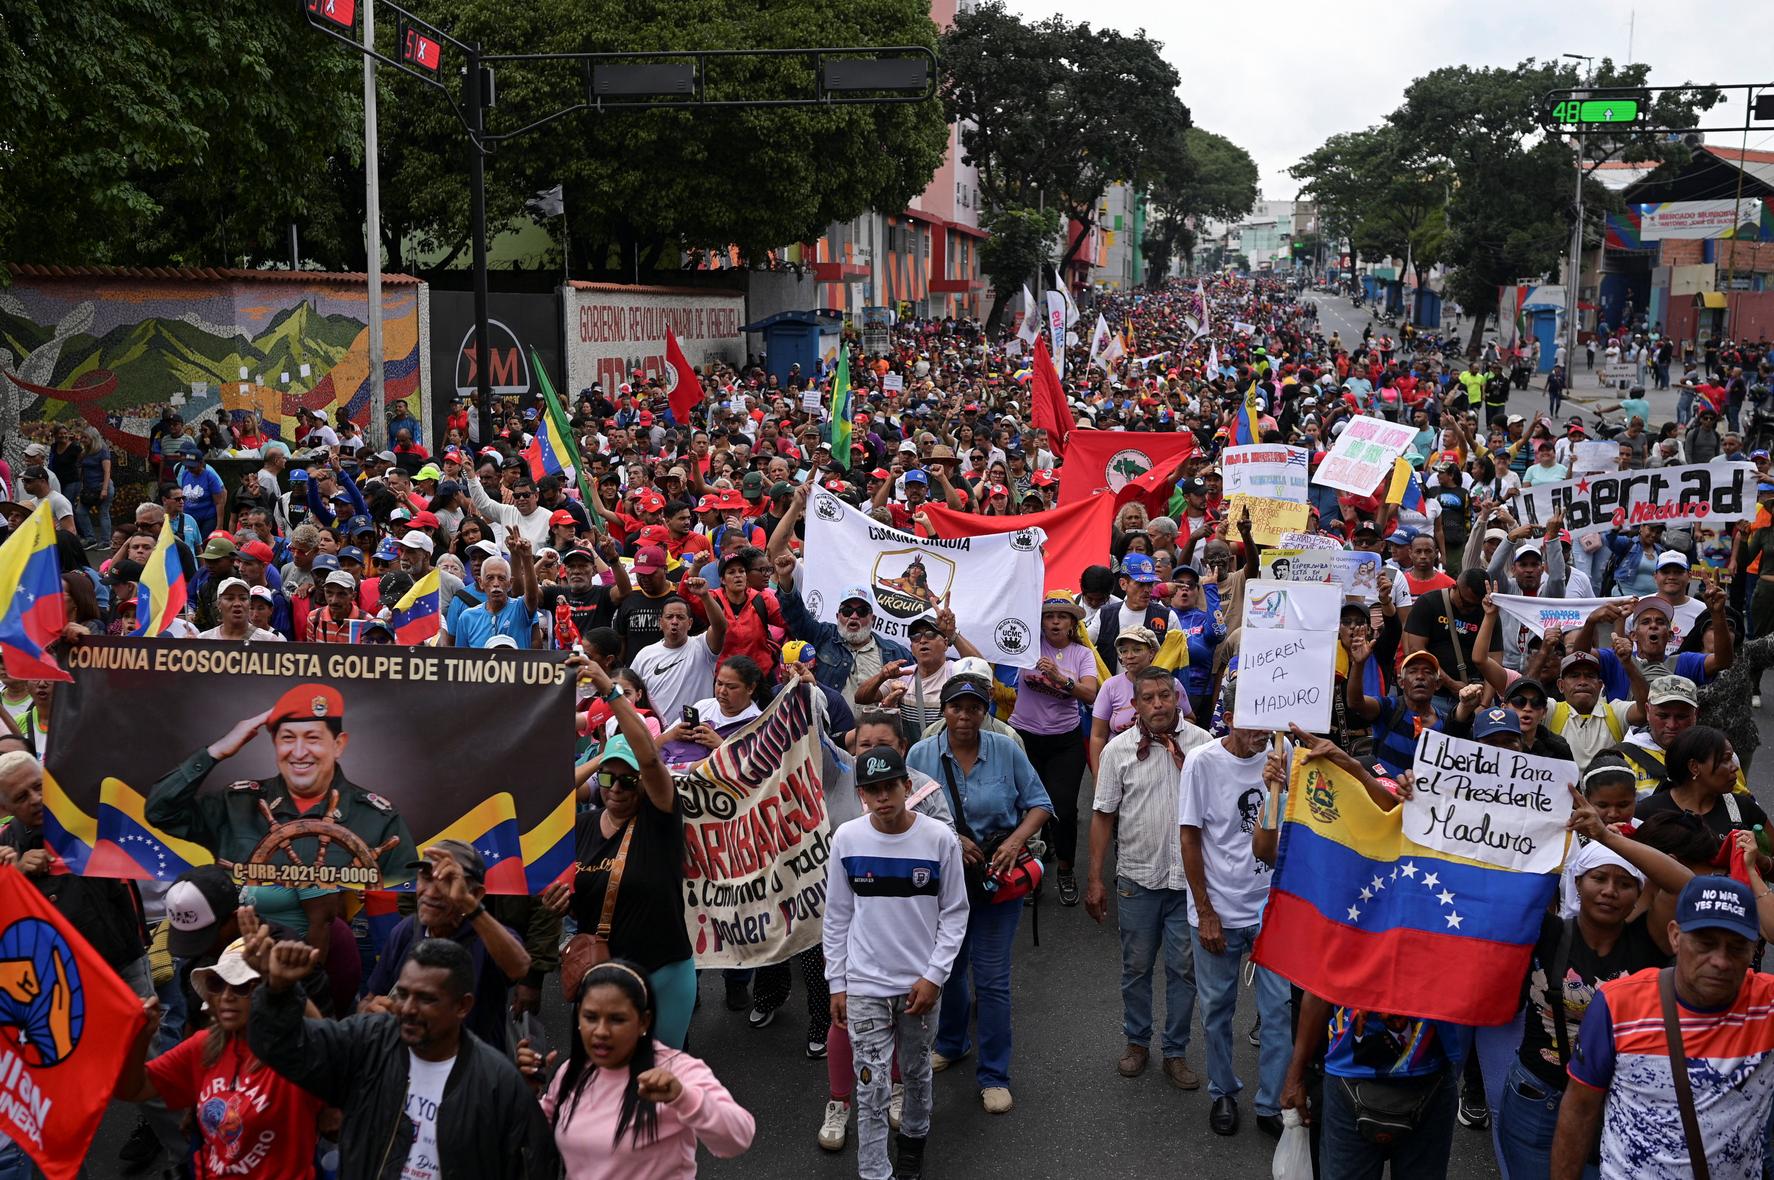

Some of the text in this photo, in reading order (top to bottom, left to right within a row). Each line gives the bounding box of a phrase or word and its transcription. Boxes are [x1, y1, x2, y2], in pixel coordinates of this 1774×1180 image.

[1552, 101, 1580, 122] 48
[580, 305, 626, 342] GOBIERNO
[695, 308, 704, 339] DE
[706, 308, 742, 338] VENEZUELA
[1524, 468, 1745, 540] Libertad
[1629, 499, 1711, 525] Maduro
[1002, 630, 1022, 638] UCMC
[68, 646, 565, 685] COMUNA ECOSOCIALISTA GOLPE DE TIMÓN UD5
[1244, 638, 1305, 670] LIBEREN
[1272, 666, 1288, 682] A
[1254, 686, 1320, 715] MADURO
[1419, 731, 1555, 783] Libertad Para
[1416, 772, 1552, 812] el Presidente
[1423, 804, 1536, 854] Maduro
[233, 862, 378, 884] C-URB-2021-07-0006
[1694, 901, 1711, 912] YES
[1702, 889, 1740, 904] NO WAR
